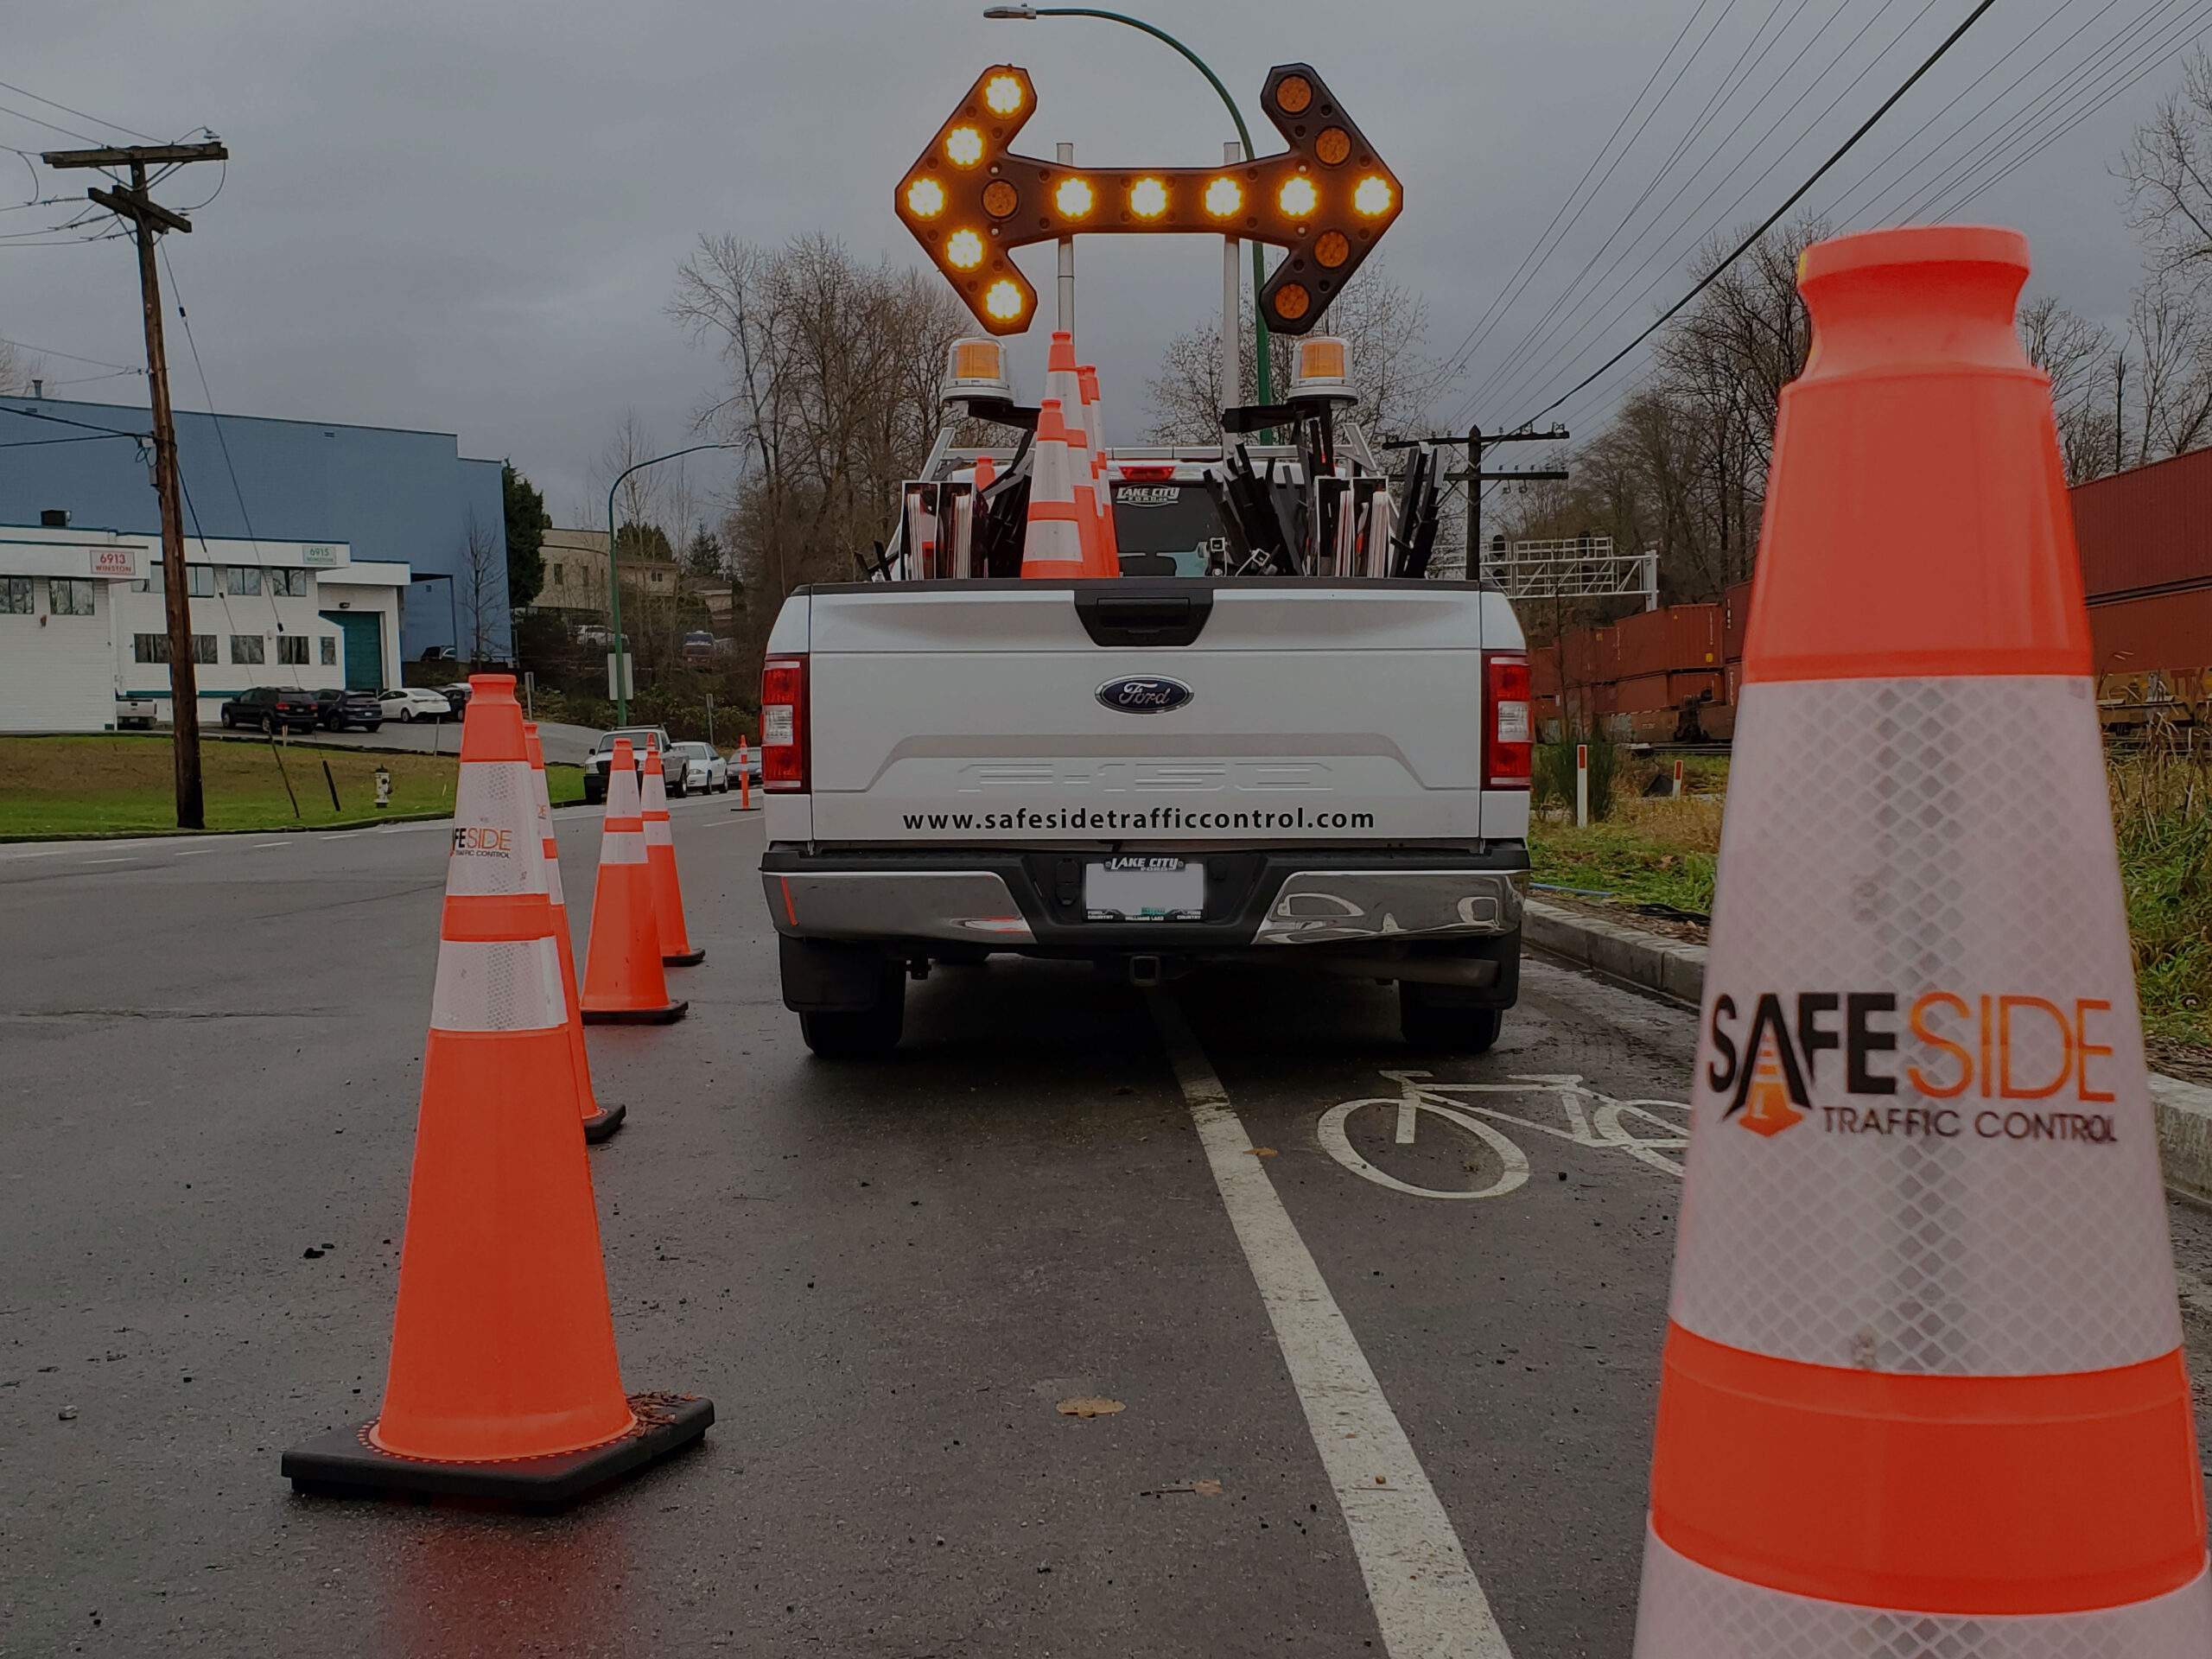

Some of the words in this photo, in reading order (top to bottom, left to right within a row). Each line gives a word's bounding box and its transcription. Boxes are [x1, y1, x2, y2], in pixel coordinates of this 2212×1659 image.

[1116, 487, 1148, 499] LAKE
[1152, 487, 1180, 499] CITY
[100, 553, 125, 563] 6913
[1119, 683, 1171, 703] Ford
[903, 808, 1374, 830] www.safesidetrafficcontrol.com
[476, 850, 510, 859] CONTROL
[1111, 857, 1146, 870] LAKE
[1148, 858, 1179, 870] CITY
[1823, 1107, 1961, 1138] TRAFFIC
[1974, 1110, 2118, 1142] CONTROL
